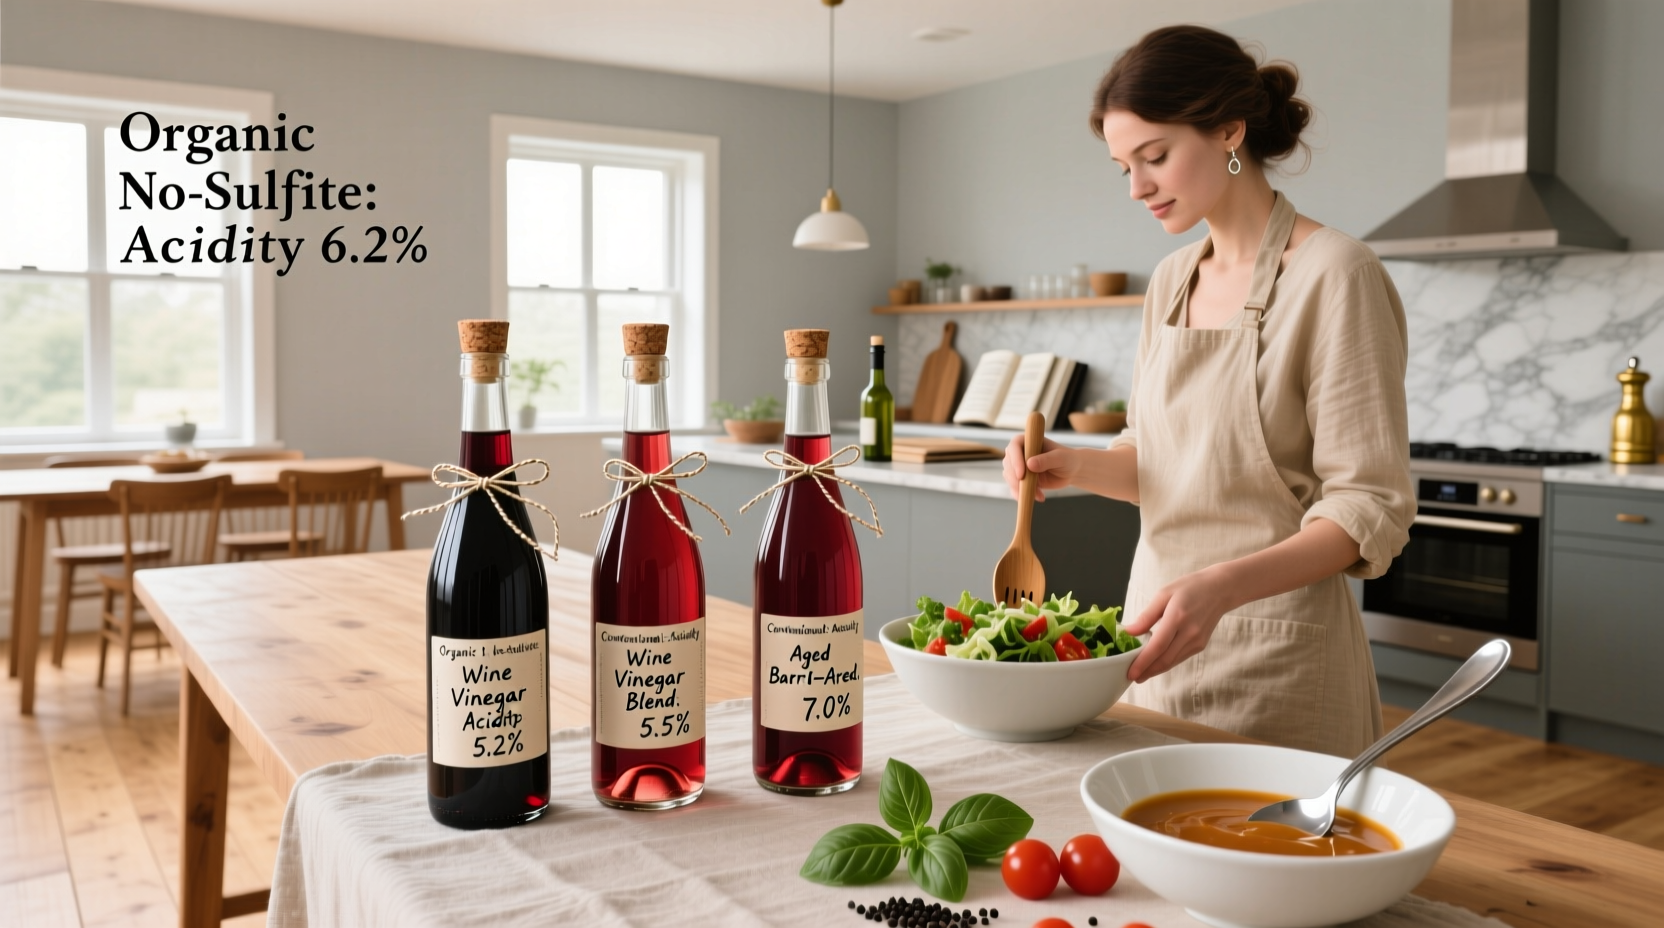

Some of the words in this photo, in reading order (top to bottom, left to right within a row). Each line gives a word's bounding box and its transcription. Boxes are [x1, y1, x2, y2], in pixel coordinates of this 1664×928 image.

[627, 648, 672, 667] Wine
[790, 643, 831, 669] Aged
[462, 664, 512, 684] Wine
[615, 669, 686, 694] Vinegar
[451, 687, 527, 713] Vinegar
[803, 692, 851, 722] 7.0%
[640, 711, 690, 738] 5.5%
[473, 729, 524, 758] 5.2%
